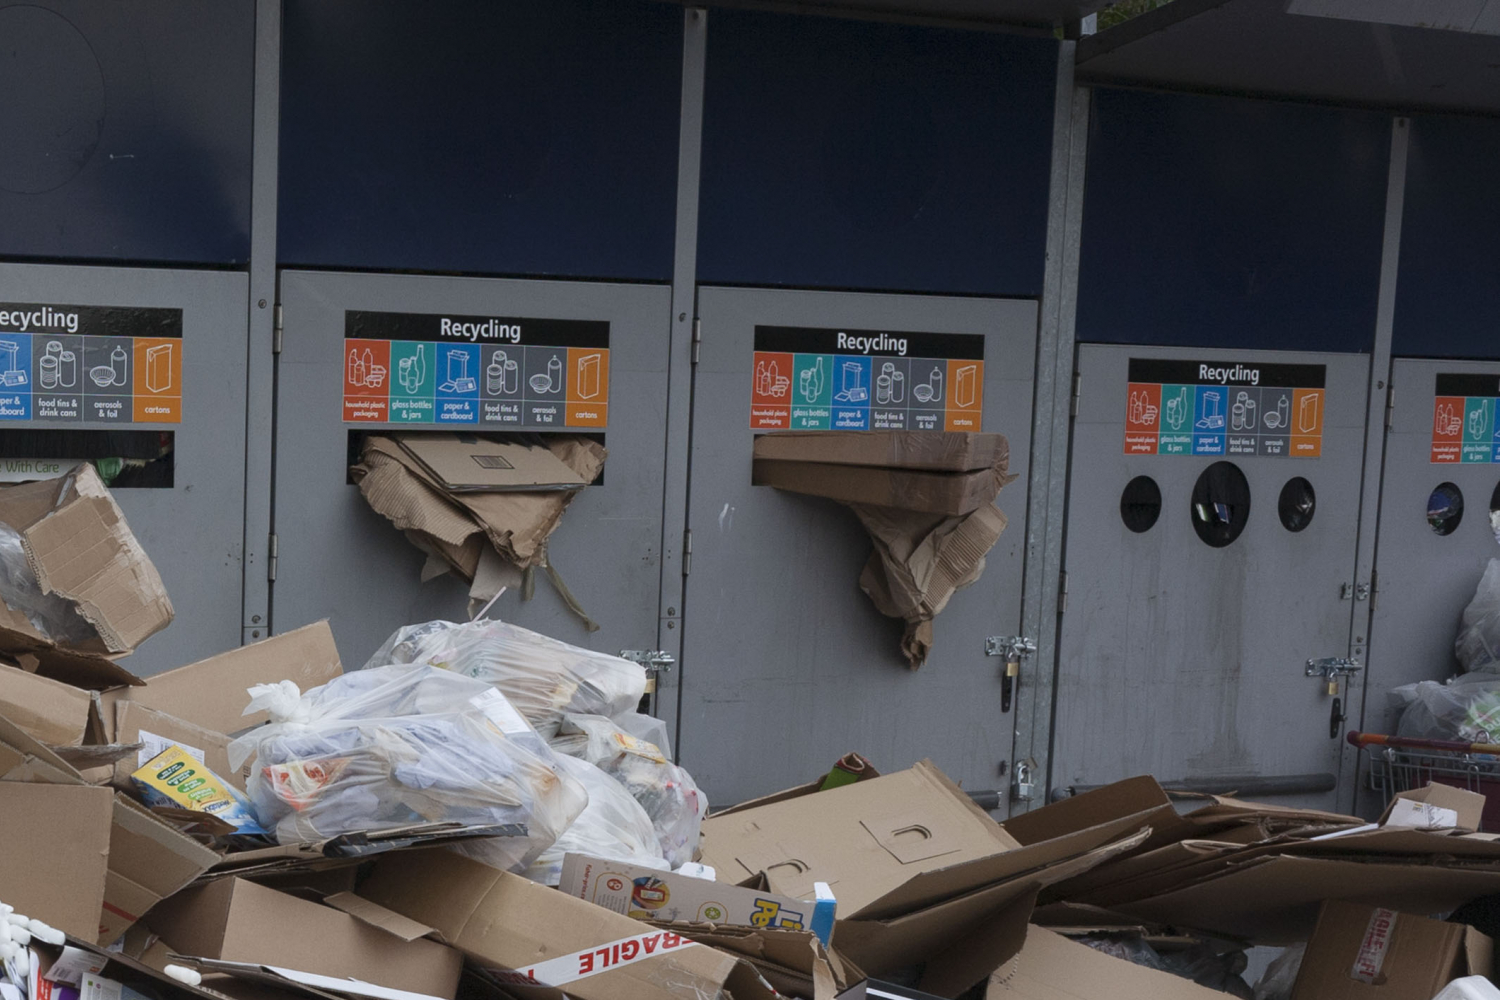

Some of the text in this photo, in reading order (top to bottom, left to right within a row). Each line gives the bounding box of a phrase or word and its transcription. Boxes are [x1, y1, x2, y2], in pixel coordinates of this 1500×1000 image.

[441, 318, 521, 343] Recycling
[837, 332, 907, 355] Recycling
[1199, 364, 1259, 384] Recycling
[38, 398, 77, 407] food tins &
[94, 400, 122, 408] aerosols
[392, 399, 432, 409] glass bottles
[444, 402, 462, 412] paper
[145, 406, 170, 414] cartons
[485, 403, 499, 412] food
[501, 404, 511, 412] tins
[532, 405, 556, 414] aerosols
[40, 408, 58, 417] drink
[107, 409, 118, 418] foil
[353, 410, 378, 418] packaging
[409, 410, 421, 420] jars
[441, 411, 472, 420] cardboard
[486, 412, 500, 421] drink
[576, 411, 597, 419] cartons
[543, 414, 552, 422] foil
